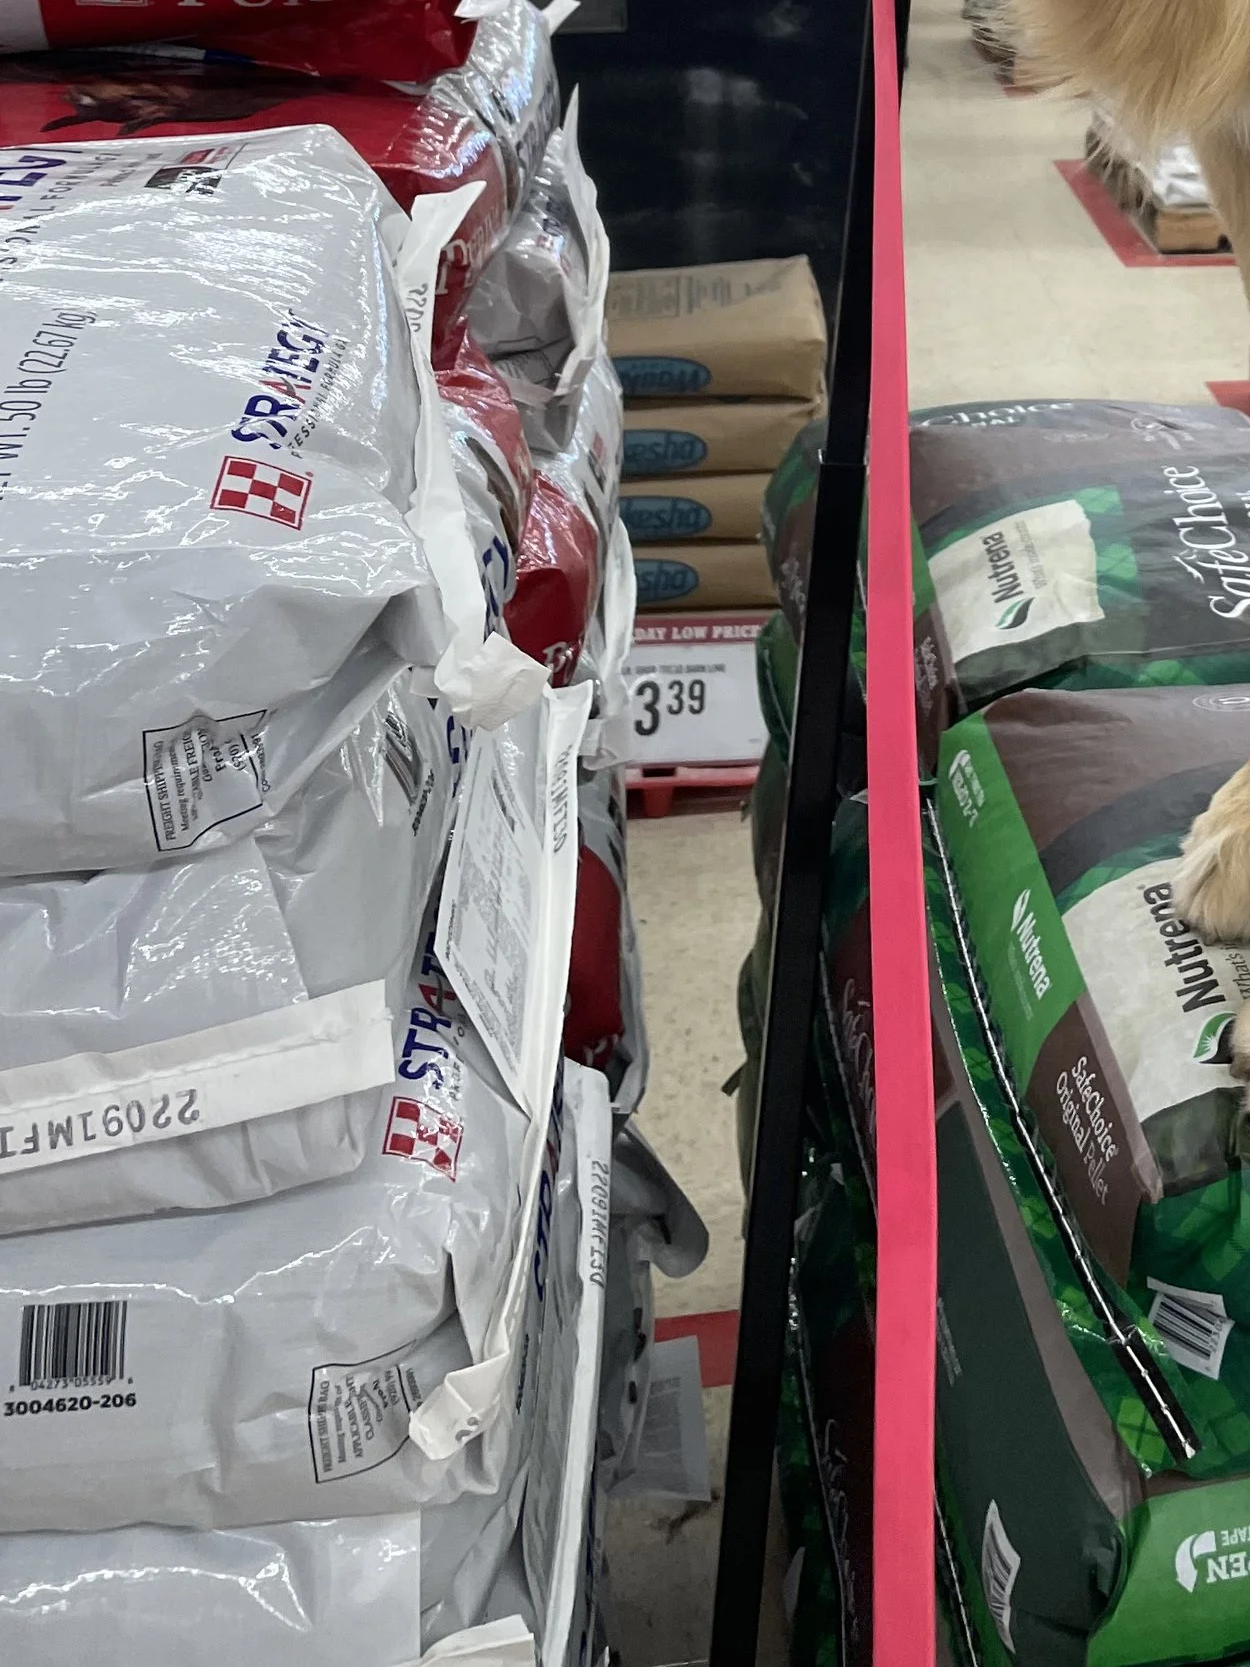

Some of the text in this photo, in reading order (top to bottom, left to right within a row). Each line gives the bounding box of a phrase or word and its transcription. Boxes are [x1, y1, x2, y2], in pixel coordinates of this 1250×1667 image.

[18, 330, 78, 374] (22.67
[6, 375, 52, 400] lb
[0, 398, 43, 424] 50
[981, 529, 1024, 604] Nutrena
[633, 626, 667, 641] DAY
[671, 626, 708, 640] LOW
[160, 803, 176, 841] FREIGHT
[179, 799, 189, 831] Meeting
[1016, 910, 1051, 1002] Nutrena
[1142, 882, 1227, 1014] Nutrena
[1071, 1055, 1118, 1162] SafeChoice
[1055, 1070, 1112, 1205] Original Pellet
[3, 1392, 137, 1417] 3004620-206
